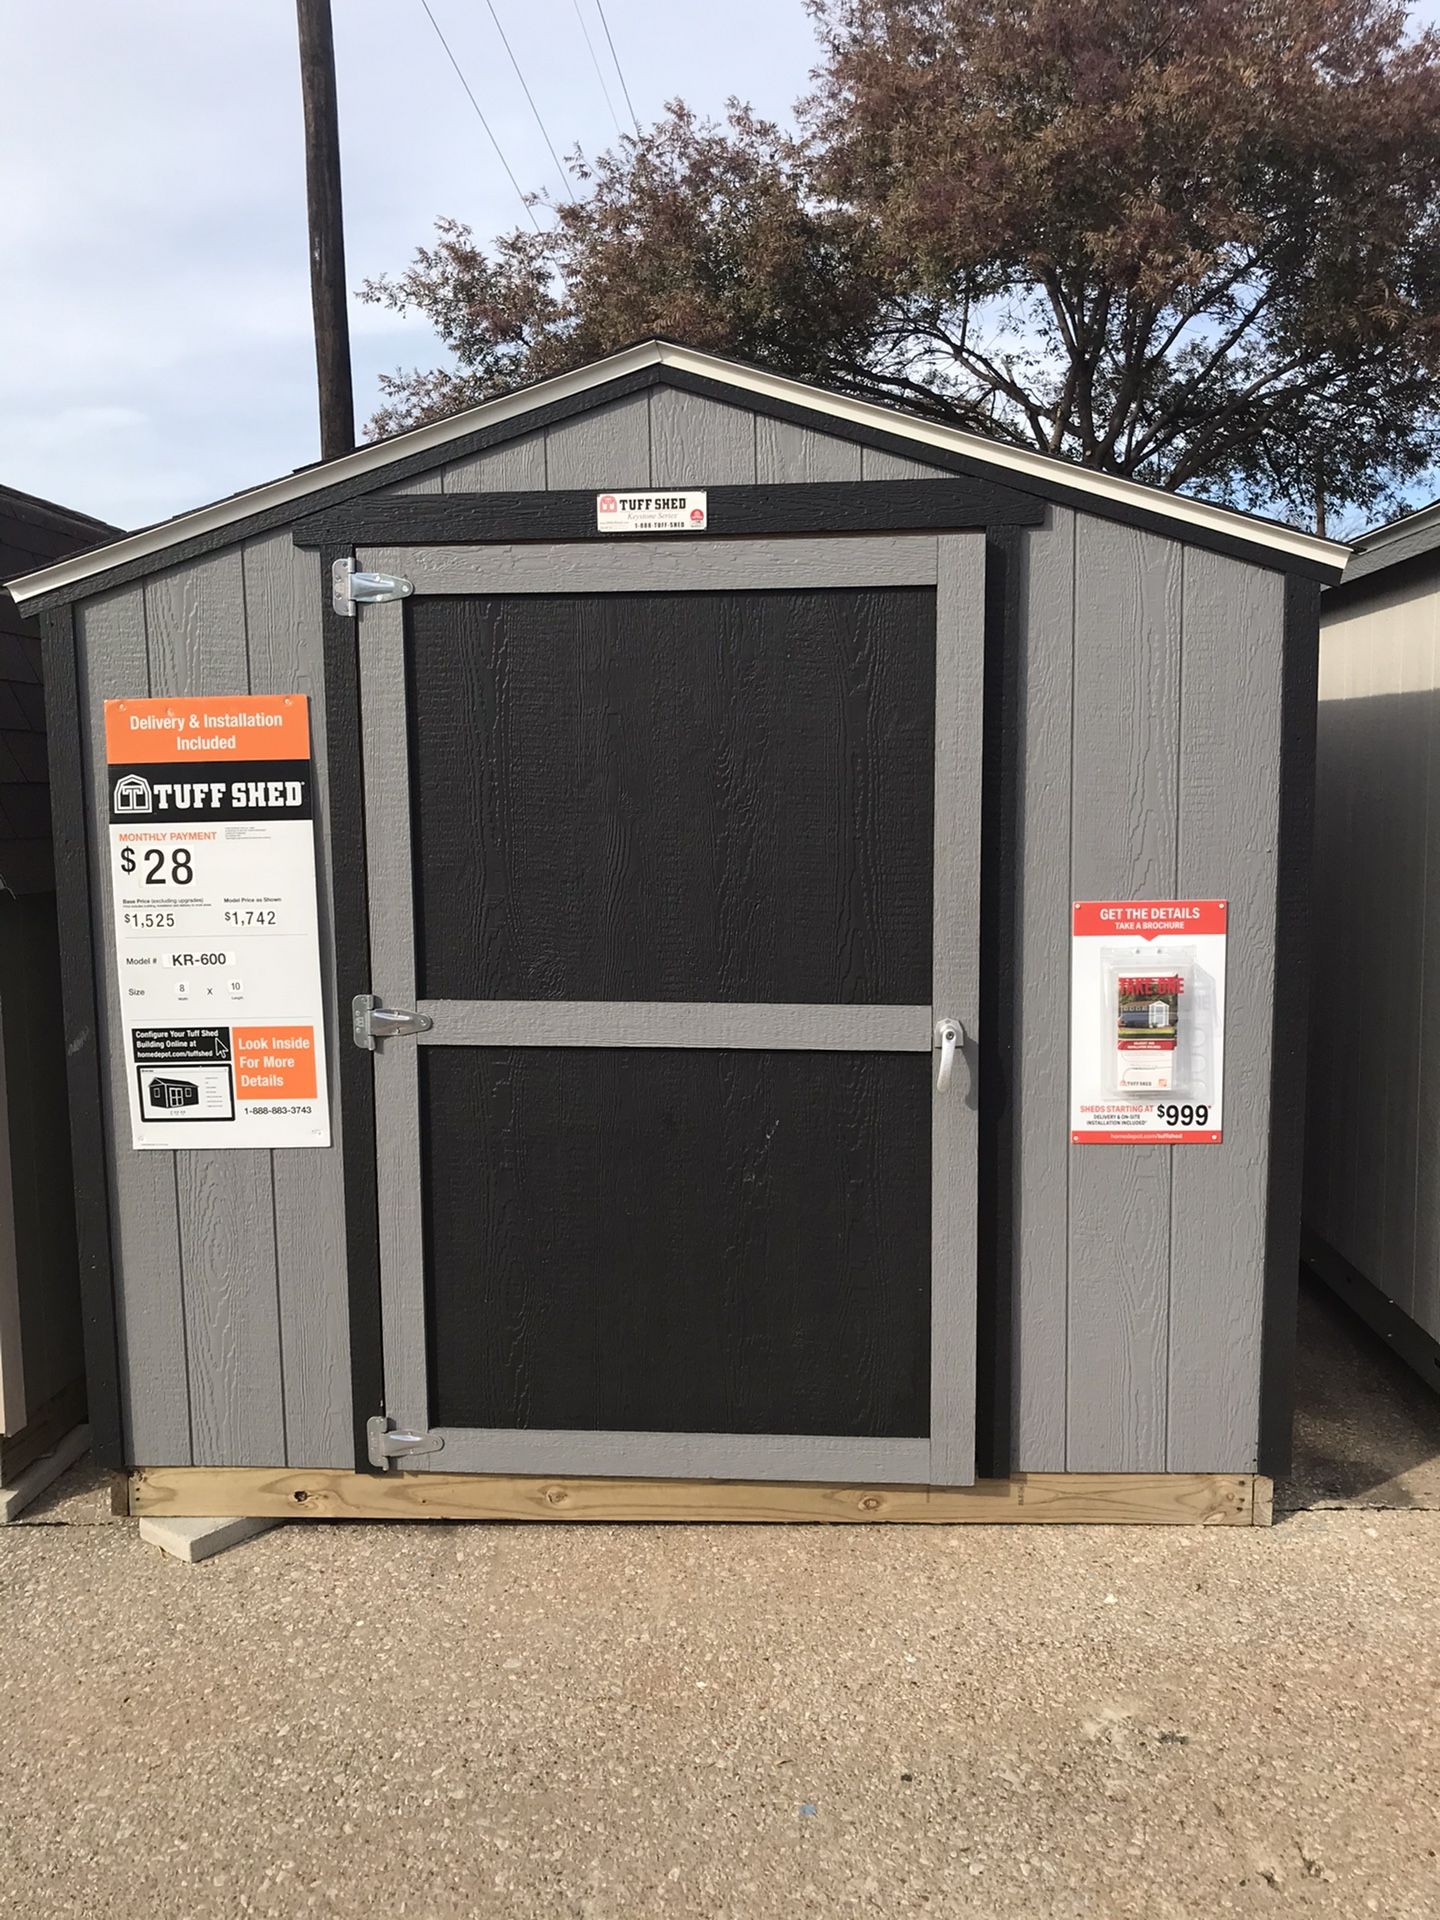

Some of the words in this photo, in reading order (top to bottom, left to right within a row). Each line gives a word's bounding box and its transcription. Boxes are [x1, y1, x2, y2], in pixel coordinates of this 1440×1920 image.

[620, 499, 652, 510] TUFF
[655, 498, 686, 510] SHED
[130, 715, 185, 731] Delivery
[189, 714, 199, 728] &
[204, 712, 282, 728] Installation
[176, 735, 236, 750] Included
[153, 783, 226, 809] TUFF
[231, 781, 303, 808] SHED
[119, 833, 167, 842] MONTHLY
[170, 831, 217, 841] PAYMENT
[224, 911, 276, 926] $1,742
[1100, 908, 1123, 920] GET
[1125, 908, 1149, 919] THE
[1151, 907, 1200, 919] DETAILS
[124, 913, 175, 928] $1,525
[1142, 921, 1184, 929] BROCHURE
[172, 953, 226, 966] KR-600
[128, 988, 145, 996] Size
[179, 984, 185, 992] 8
[231, 982, 241, 990] 10
[1119, 978, 1152, 995] TAKE
[135, 1031, 168, 1039] Configure
[136, 1041, 164, 1049] Building
[238, 1038, 268, 1050] Look
[272, 1037, 310, 1049] Inside
[137, 1050, 213, 1058] homedepot.com/tuffshed
[239, 1056, 260, 1068] For
[263, 1056, 295, 1068] More
[241, 1075, 284, 1087] Details
[244, 1106, 312, 1114] 1-888-883-3743
[1080, 1105, 1105, 1113] SHEDS
